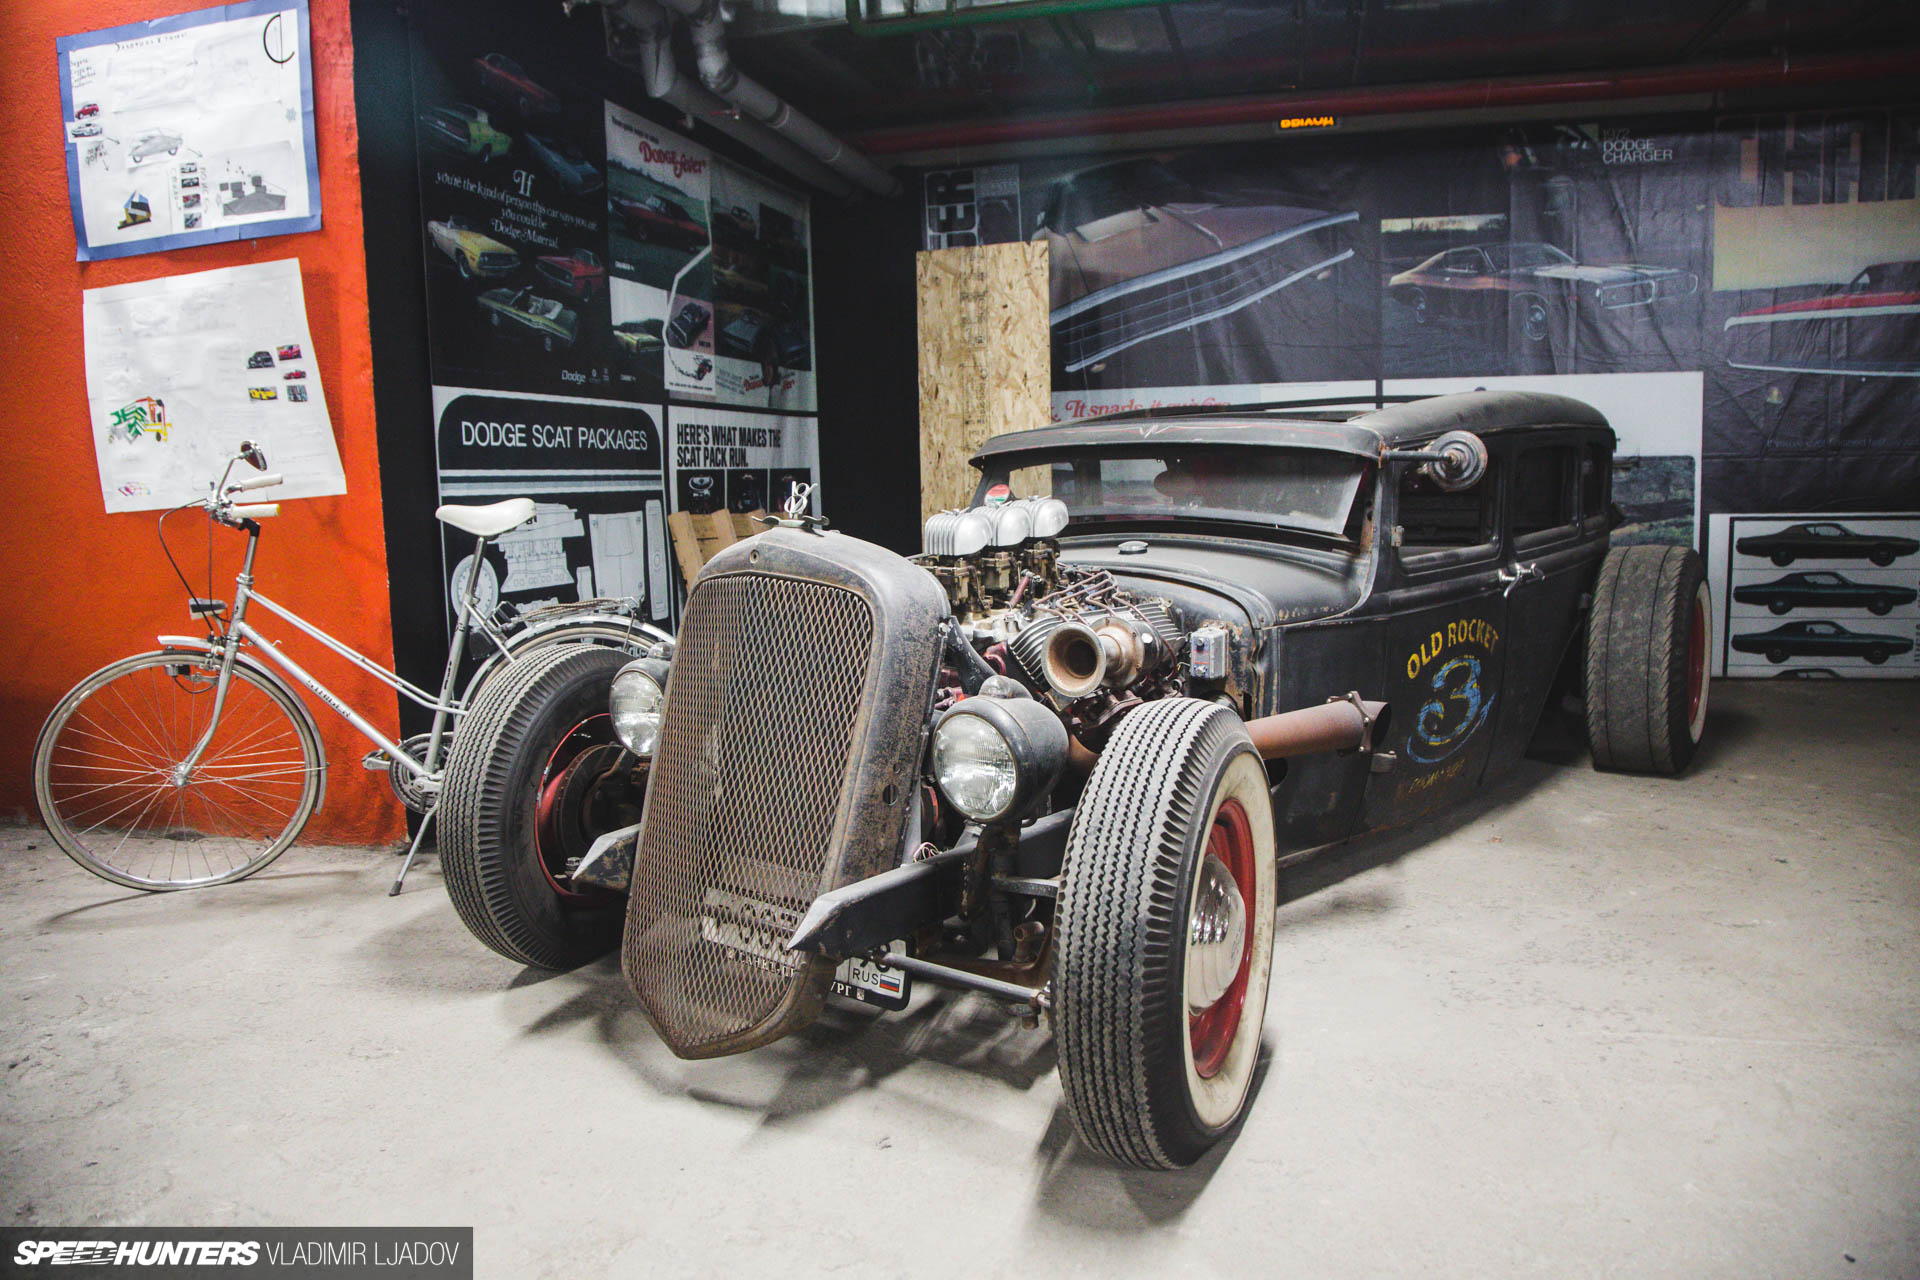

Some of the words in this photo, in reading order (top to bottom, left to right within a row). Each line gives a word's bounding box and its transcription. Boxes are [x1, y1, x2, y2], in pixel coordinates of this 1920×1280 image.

[1603, 138, 1655, 152] DODGE
[1602, 149, 1673, 164] CHARGER
[463, 178, 477, 193] the
[477, 181, 498, 199] kind
[513, 169, 535, 197] If
[561, 369, 587, 385] Dodge
[461, 421, 527, 447] DODGE
[532, 425, 573, 448] SCAT
[578, 427, 648, 450] PACKAGES
[677, 423, 709, 445] HERE'S
[711, 426, 738, 446] WHAT
[738, 427, 767, 447] MAKES
[768, 429, 781, 448] THE
[677, 446, 701, 467] SCAT
[703, 447, 727, 467] PACK
[729, 447, 749, 467] RUN.
[1407, 631, 1443, 680] OLD
[1448, 618, 1499, 654] ROCKET
[1417, 655, 1481, 746] 3
[852, 967, 879, 986] RUS
